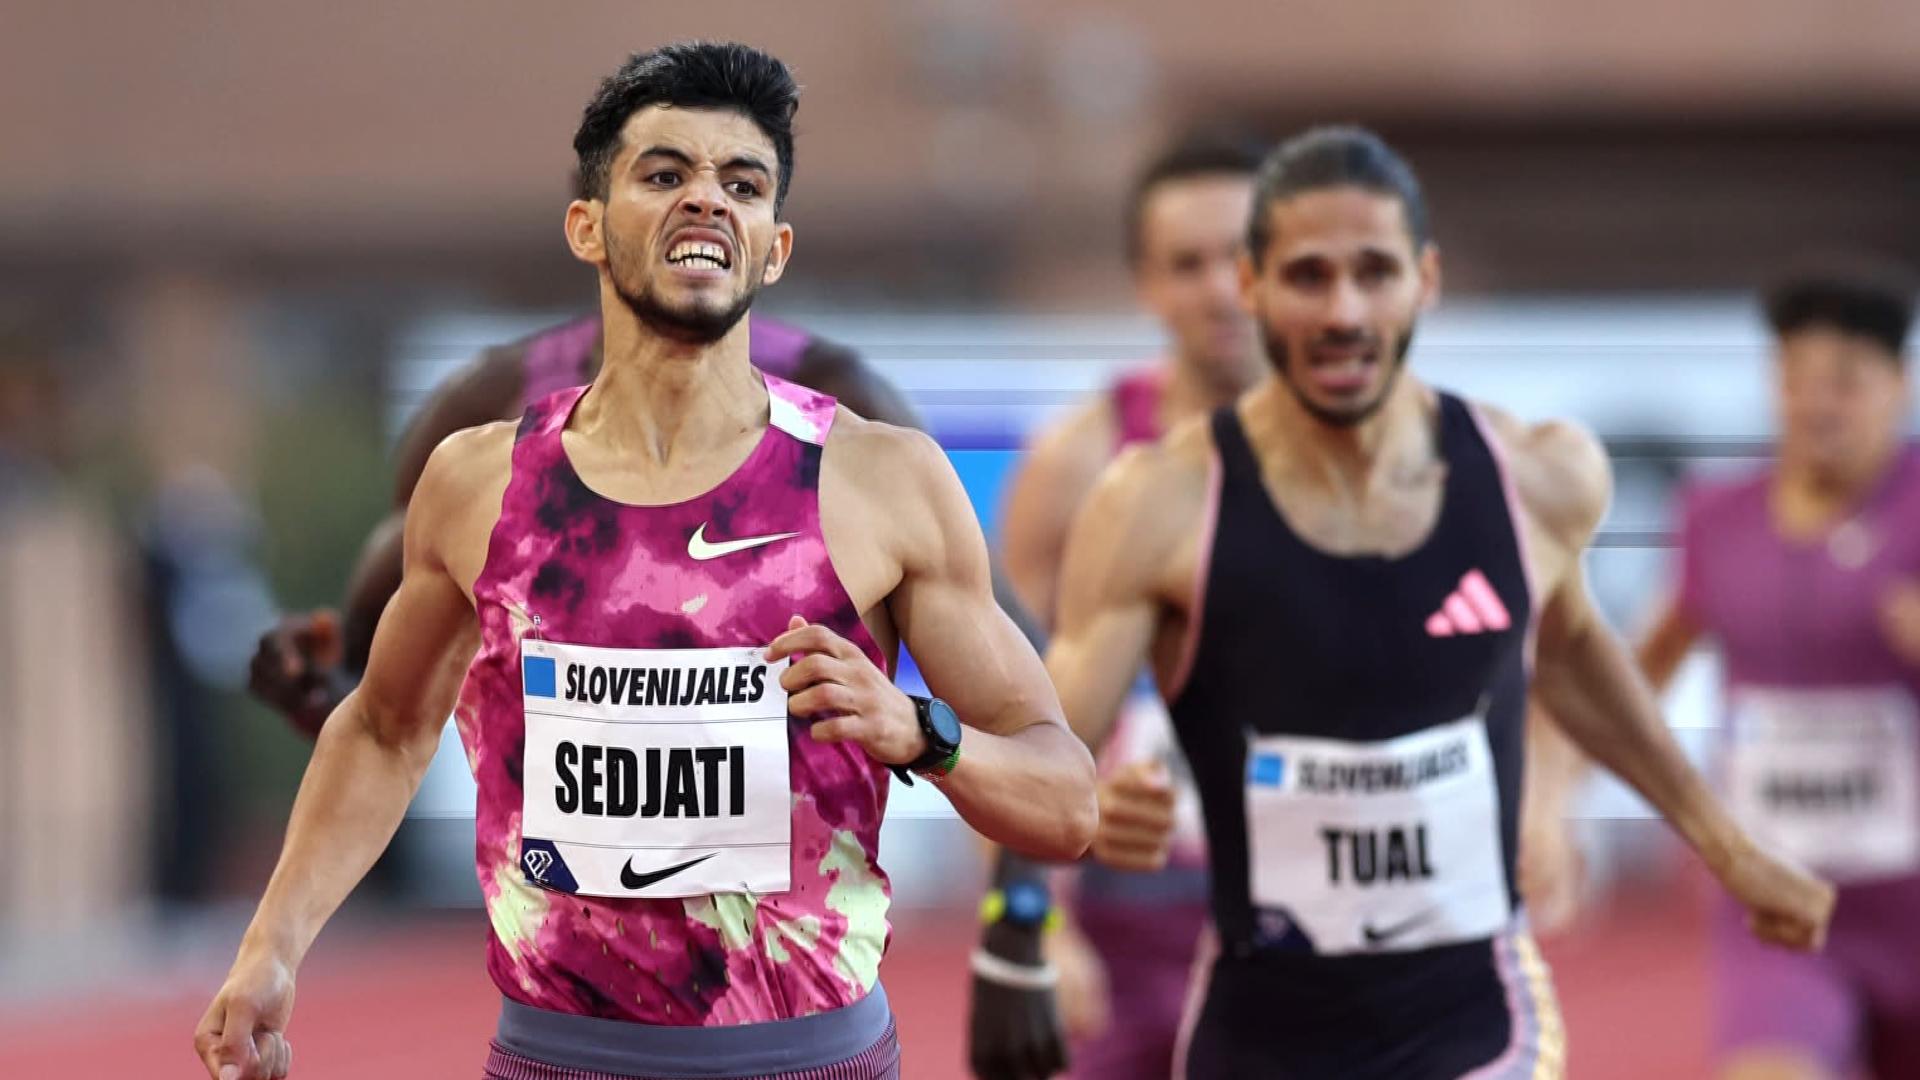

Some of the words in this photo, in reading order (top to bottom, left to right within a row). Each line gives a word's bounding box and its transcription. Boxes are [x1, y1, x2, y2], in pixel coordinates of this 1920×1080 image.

[565, 663, 767, 706] SLOVENIJALES
[554, 740, 745, 818] SEDJATI
[1321, 823, 1434, 885] TUAL
